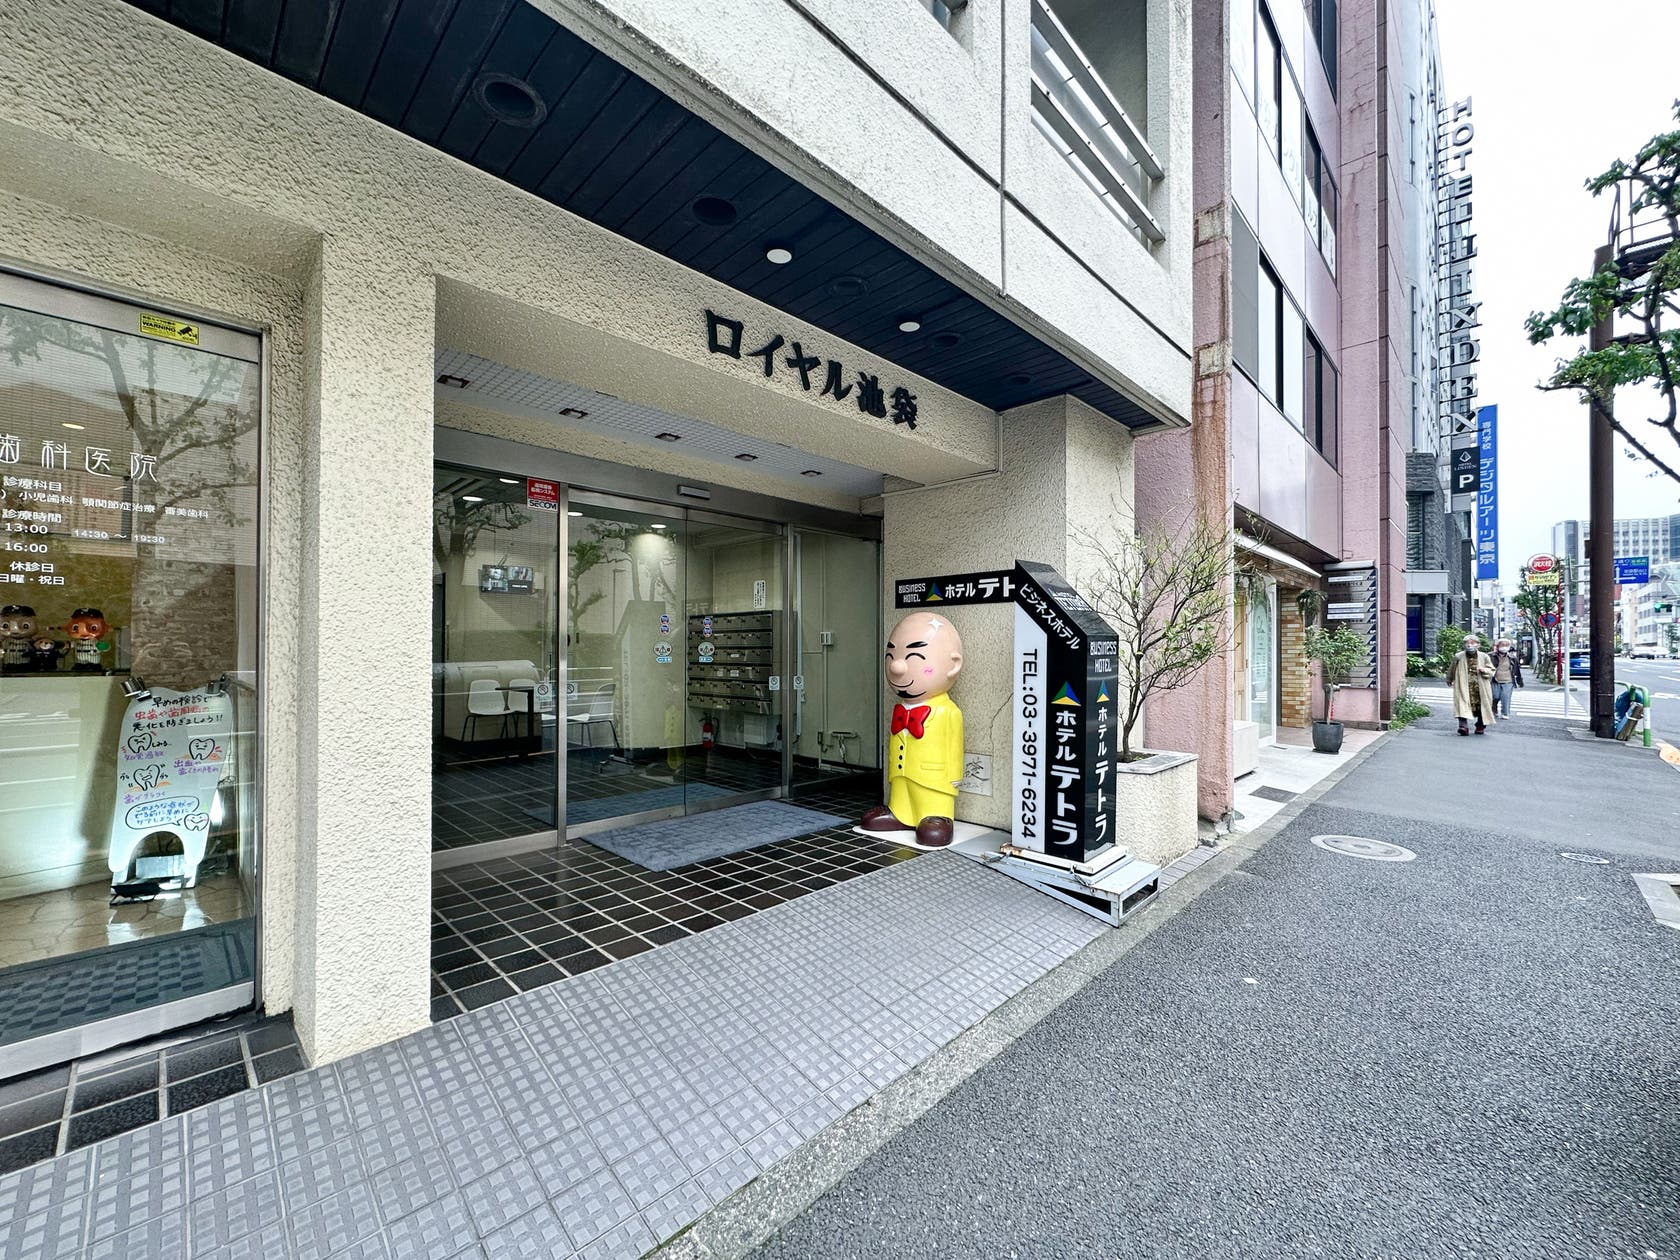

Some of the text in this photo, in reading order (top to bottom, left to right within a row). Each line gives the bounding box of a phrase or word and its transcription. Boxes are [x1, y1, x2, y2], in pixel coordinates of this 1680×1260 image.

[1452, 96, 1475, 225] HOTEL
[143, 321, 176, 332] WARNING
[1450, 233, 1483, 436] LINDEN
[705, 309, 918, 430] ロイヤル池袋
[0, 433, 158, 483] 歯科医院
[3, 475, 62, 492] 診療科目
[1459, 474, 1474, 488] P
[19, 491, 73, 505] 小児歯科
[529, 500, 557, 510] SECOM
[2, 508, 62, 523] 診療時間
[5, 522, 48, 534] 13:00
[74, 530, 108, 539] 14:30
[133, 534, 165, 543] 19:30
[4, 542, 48, 553] 16:00
[10, 561, 54, 573] 休診日
[0, 573, 65, 585] 日曜・祝日
[898, 583, 926, 594] BUSINESS
[903, 594, 921, 603] HOTEL
[1020, 583, 1080, 649] ビジネスホテル
[1090, 641, 1117, 656] BUSINESS
[1094, 658, 1112, 672] HOTEL
[1021, 648, 1038, 839] TEL:03-3971-6234
[1050, 710, 1081, 845] ホテルテトラ
[1095, 706, 1109, 842] ホテルテトラ
